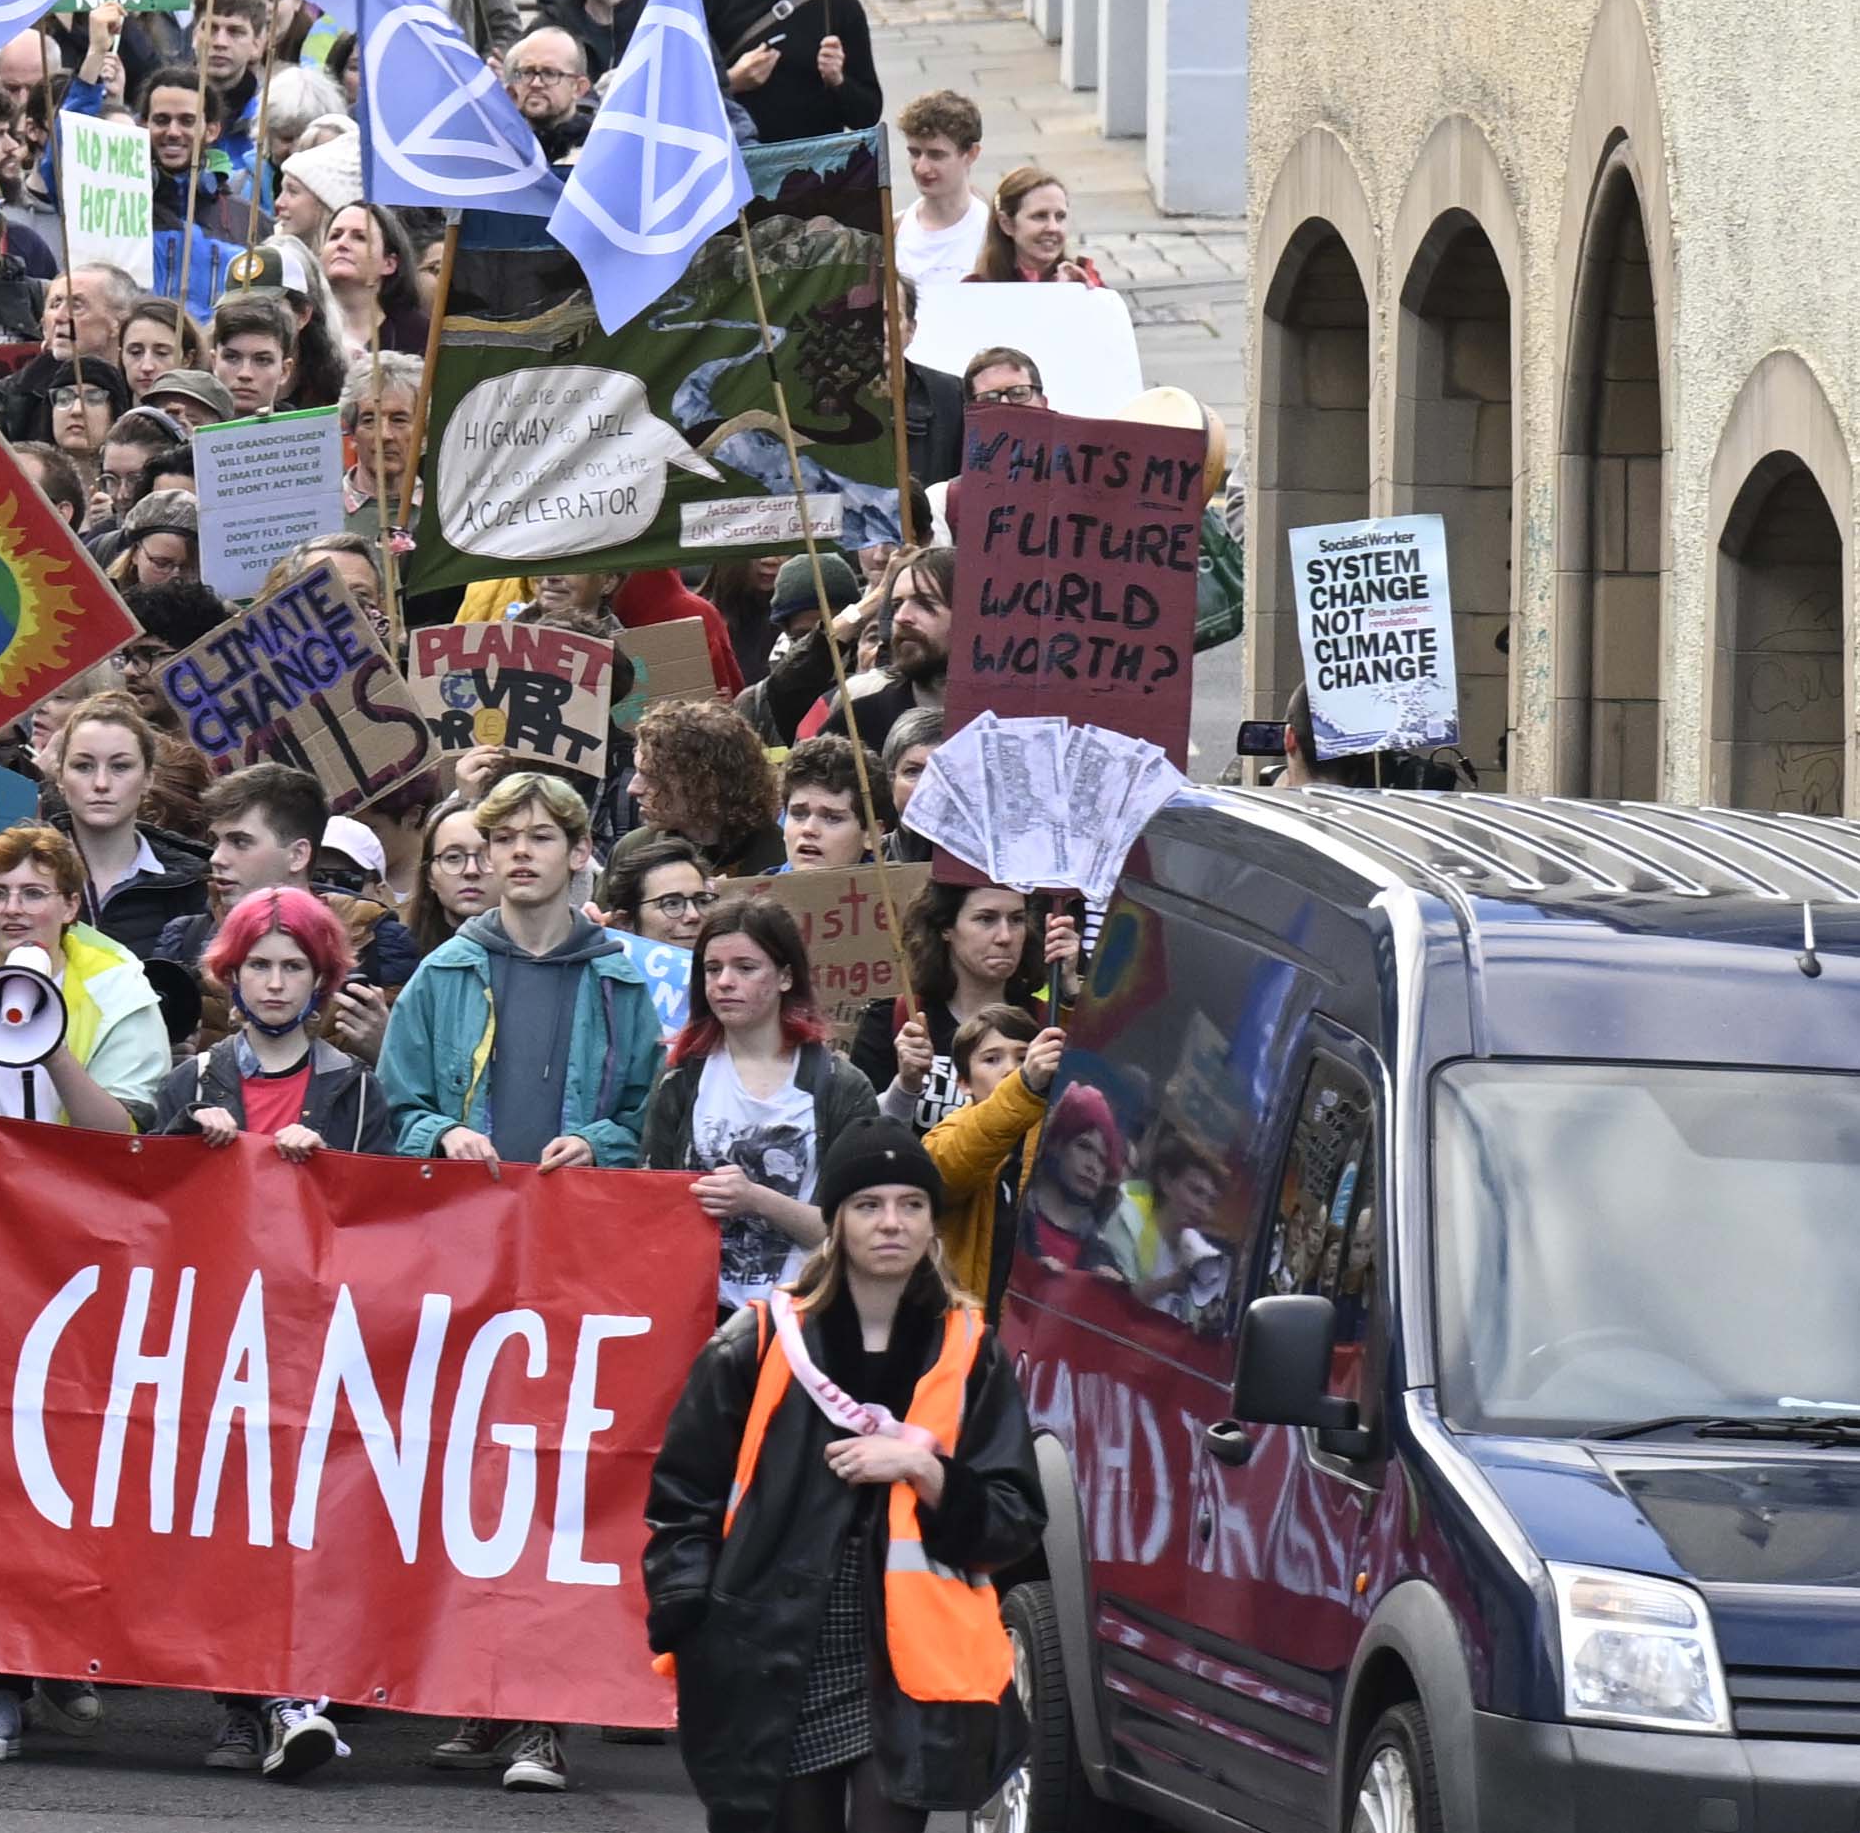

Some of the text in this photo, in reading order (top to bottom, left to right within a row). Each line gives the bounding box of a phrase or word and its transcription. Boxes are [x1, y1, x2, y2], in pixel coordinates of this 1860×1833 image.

[76, 127, 145, 175] NO MORE
[80, 188, 149, 237] HOT AIR
[211, 431, 326, 454] OUR GRANDCHILDREN
[244, 451, 280, 465] BLAME
[283, 449, 297, 458] US
[300, 446, 321, 456] FOR
[969, 429, 1203, 502] WHAT'S MY
[217, 474, 324, 498] WE DON'T ACT NOW
[218, 469, 262, 483] CLIMATE
[265, 462, 308, 476] CHANGE
[460, 486, 638, 532] ACCELERATOR
[983, 505, 1196, 571] FUTURE
[1307, 548, 1420, 585] SYSTEM
[980, 572, 1161, 632] WORLD
[1310, 574, 1429, 610] CHANGE
[163, 566, 348, 711] CLIMATE
[1312, 608, 1365, 638] NOT
[1315, 628, 1437, 664] CLIMATE
[416, 624, 614, 696] PLANET
[973, 631, 1179, 699] WORTH?
[1318, 655, 1437, 691] CHANGE
[187, 619, 372, 756] CHANGE
[12, 1264, 652, 1586] CHANGE
